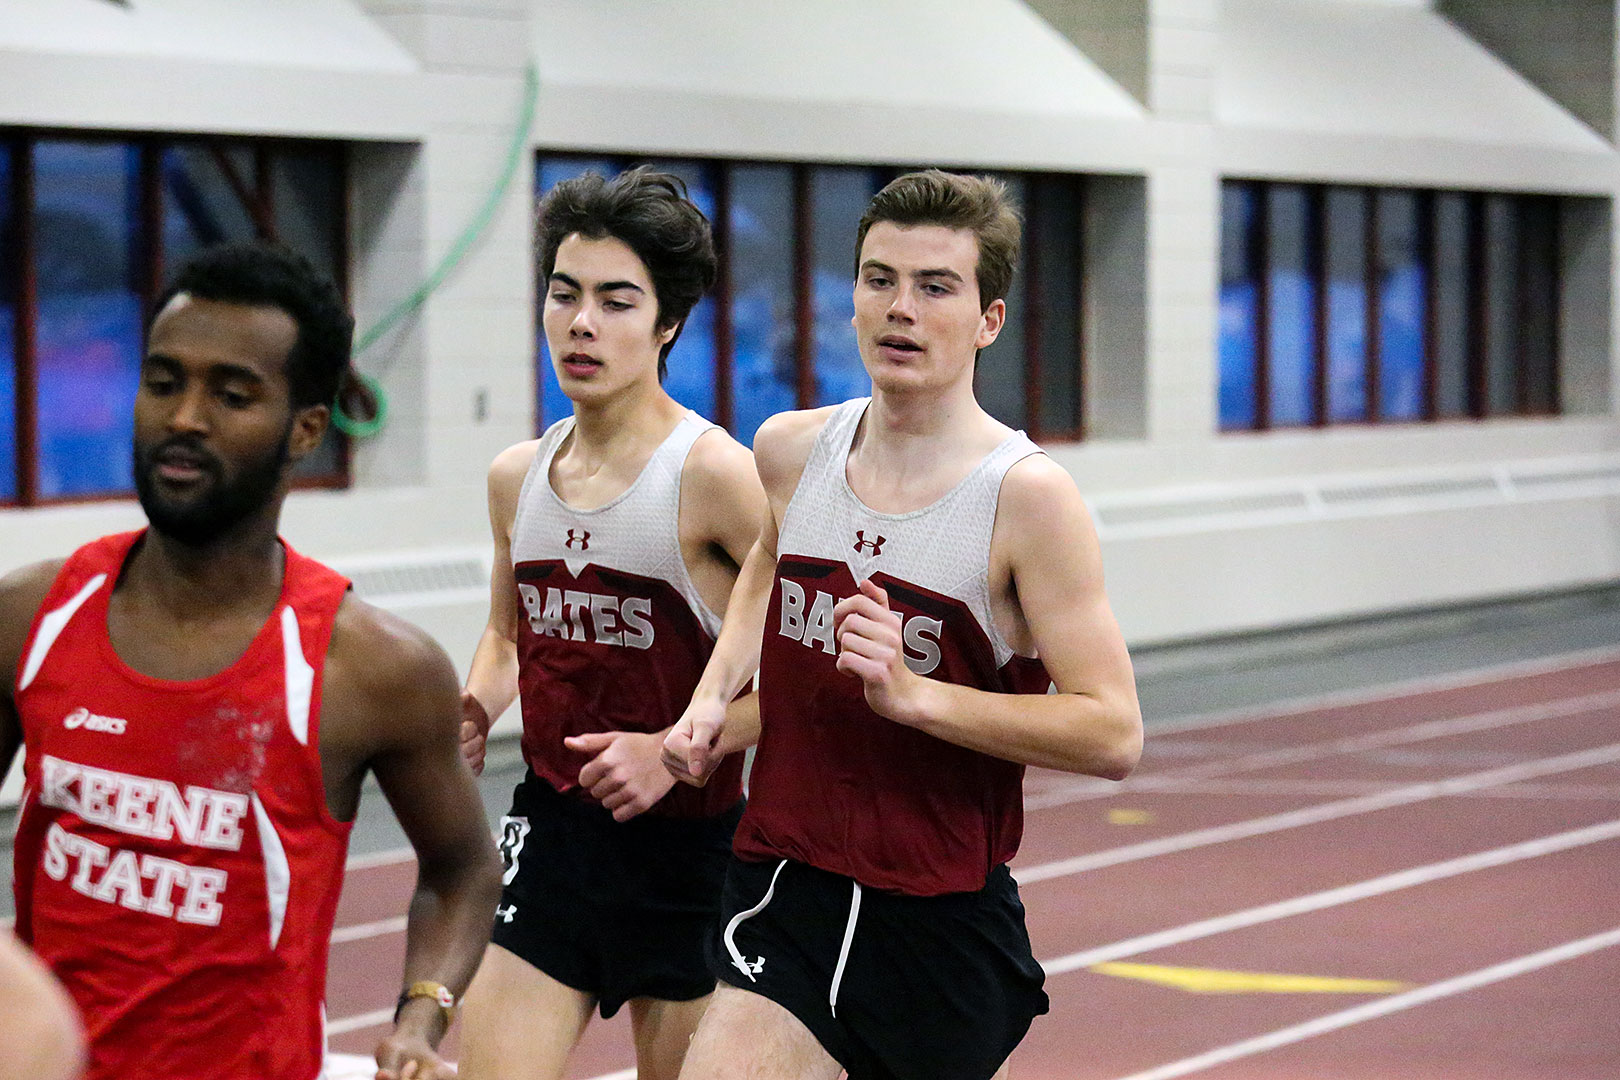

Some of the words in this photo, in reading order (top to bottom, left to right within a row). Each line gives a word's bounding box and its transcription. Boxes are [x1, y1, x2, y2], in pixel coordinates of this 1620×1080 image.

[518, 583, 655, 650] BATES
[778, 577, 943, 675] BAS
[40, 753, 250, 852] KEENE
[43, 821, 229, 927] STATE
